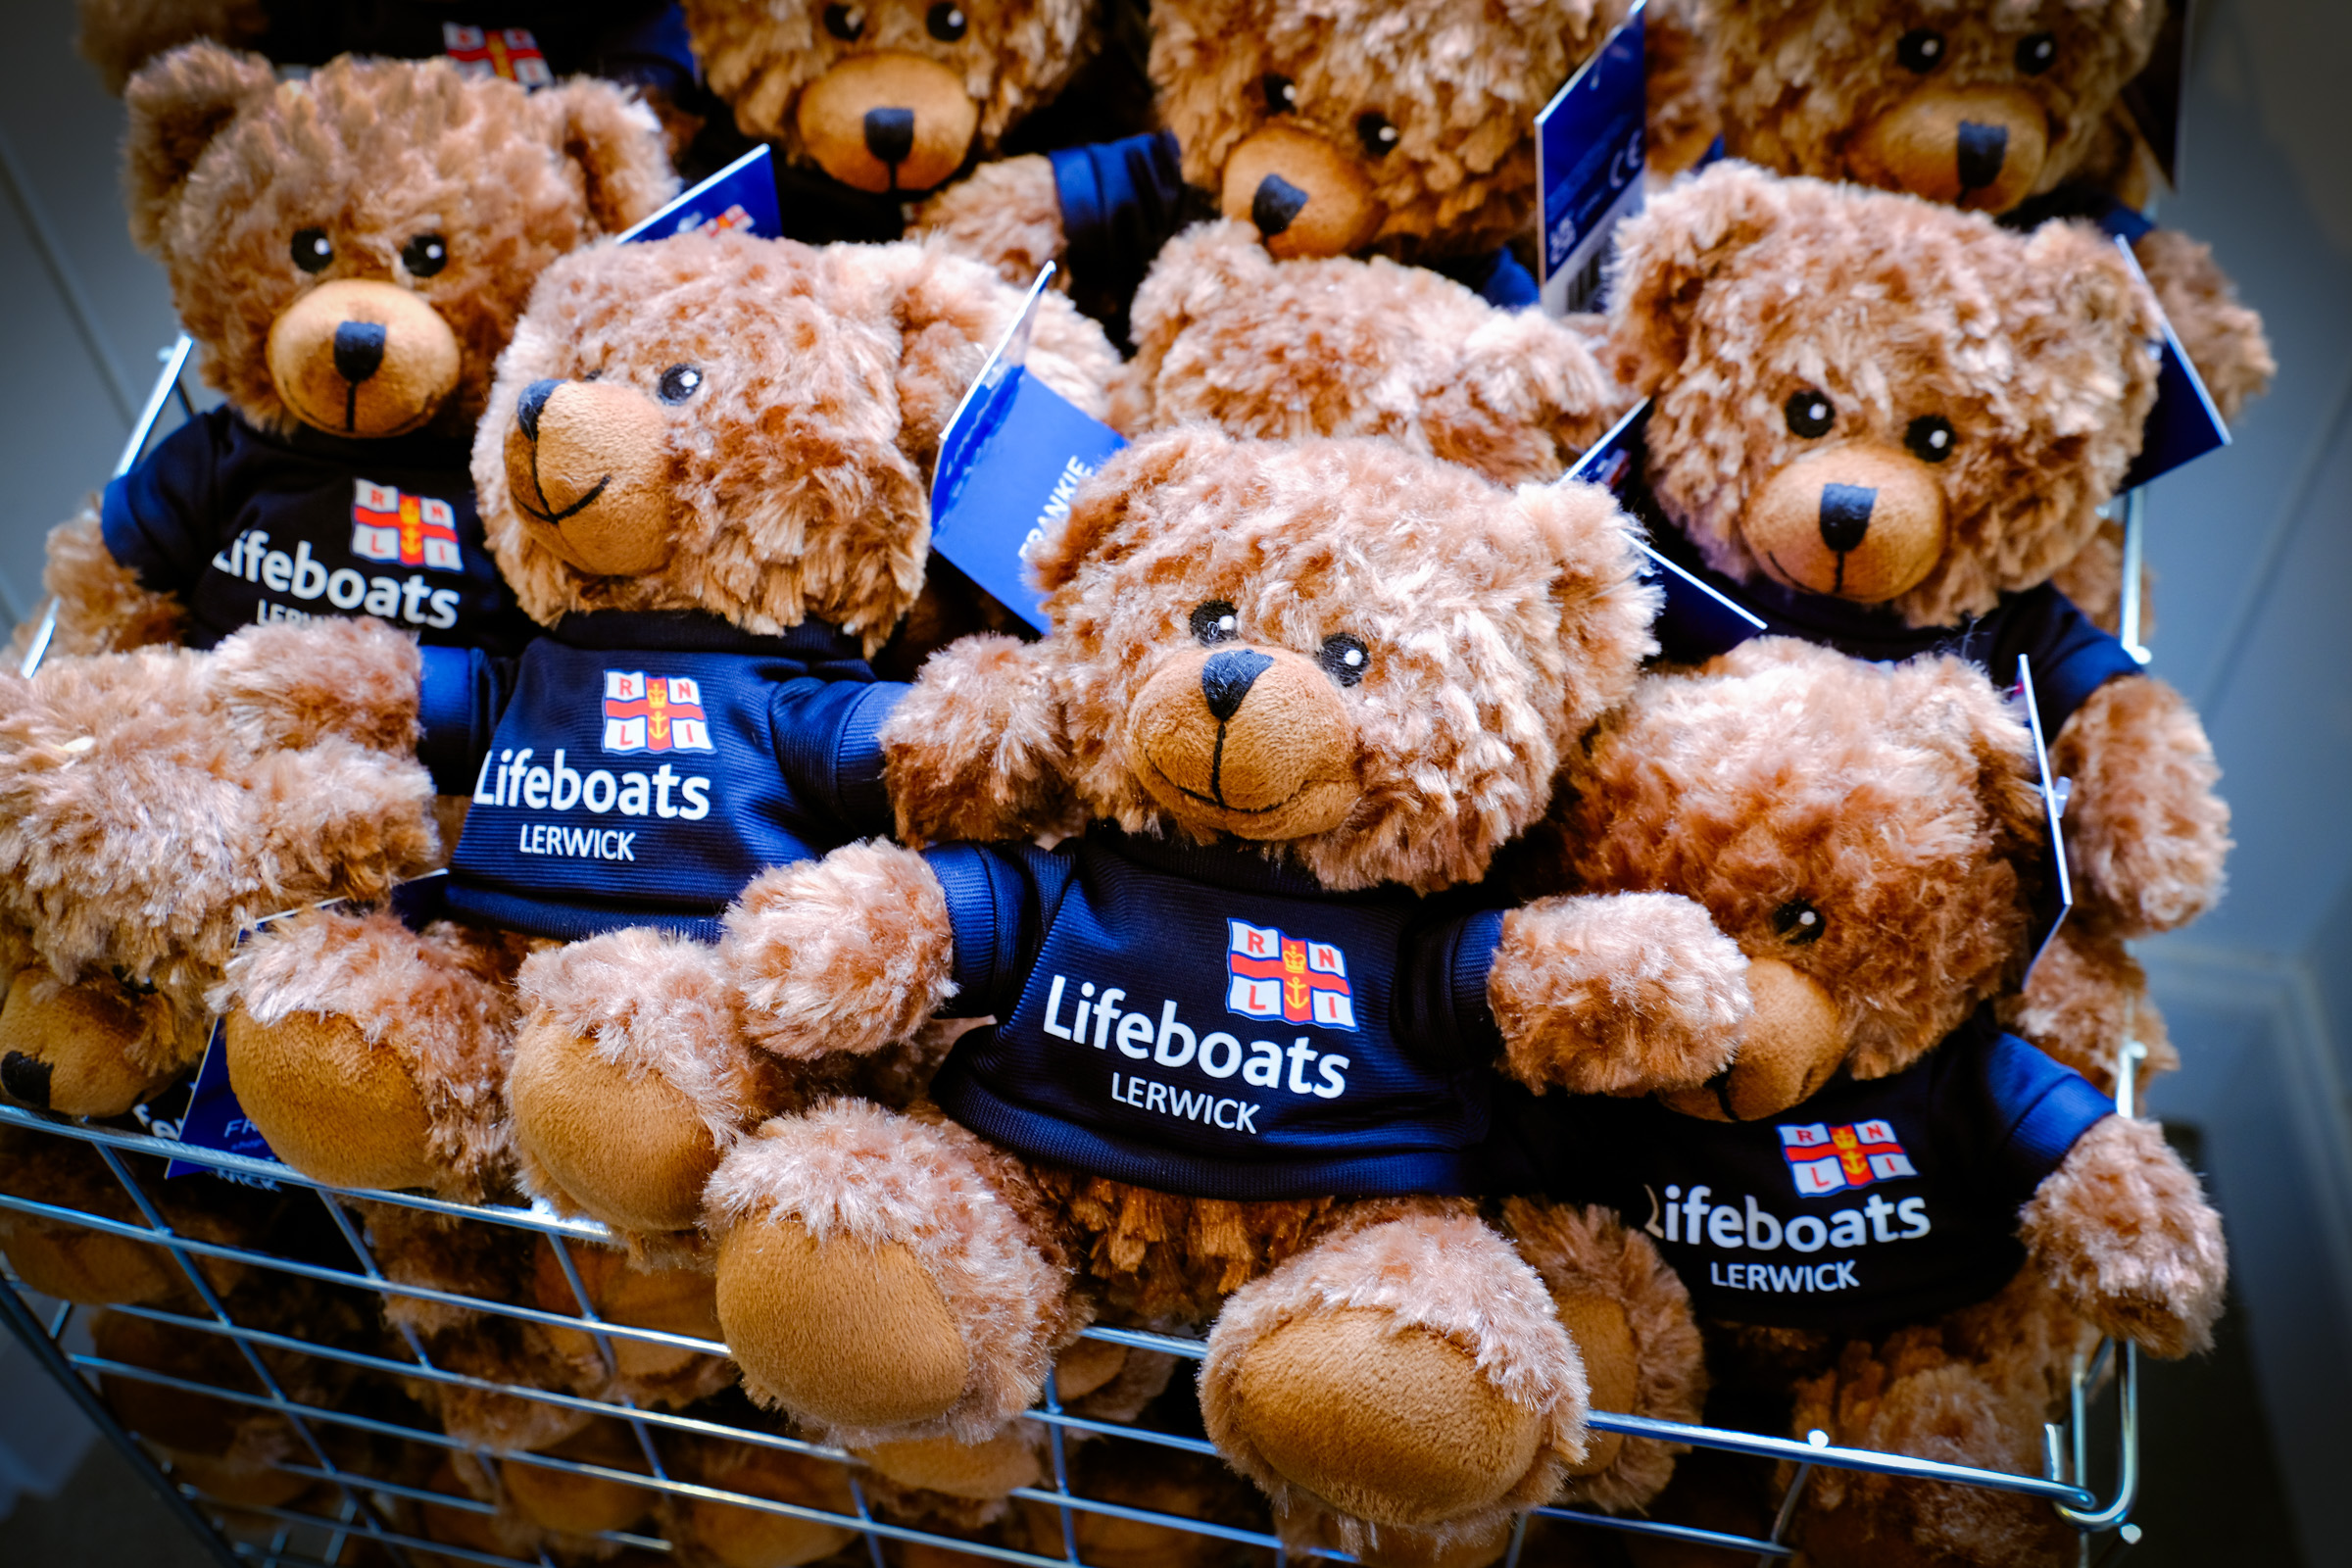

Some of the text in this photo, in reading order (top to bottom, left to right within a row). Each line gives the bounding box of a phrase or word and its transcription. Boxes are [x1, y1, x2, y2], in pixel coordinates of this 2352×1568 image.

[472, 748, 711, 820] Lifeboats
[519, 824, 636, 861] LERWICK
[1247, 929, 1335, 968] R N
[1248, 985, 1266, 1010] L
[1043, 974, 1350, 1099] Lifeboats
[1111, 1071, 1260, 1134] LERWICK
[1710, 1259, 1860, 1293] LERWICK
